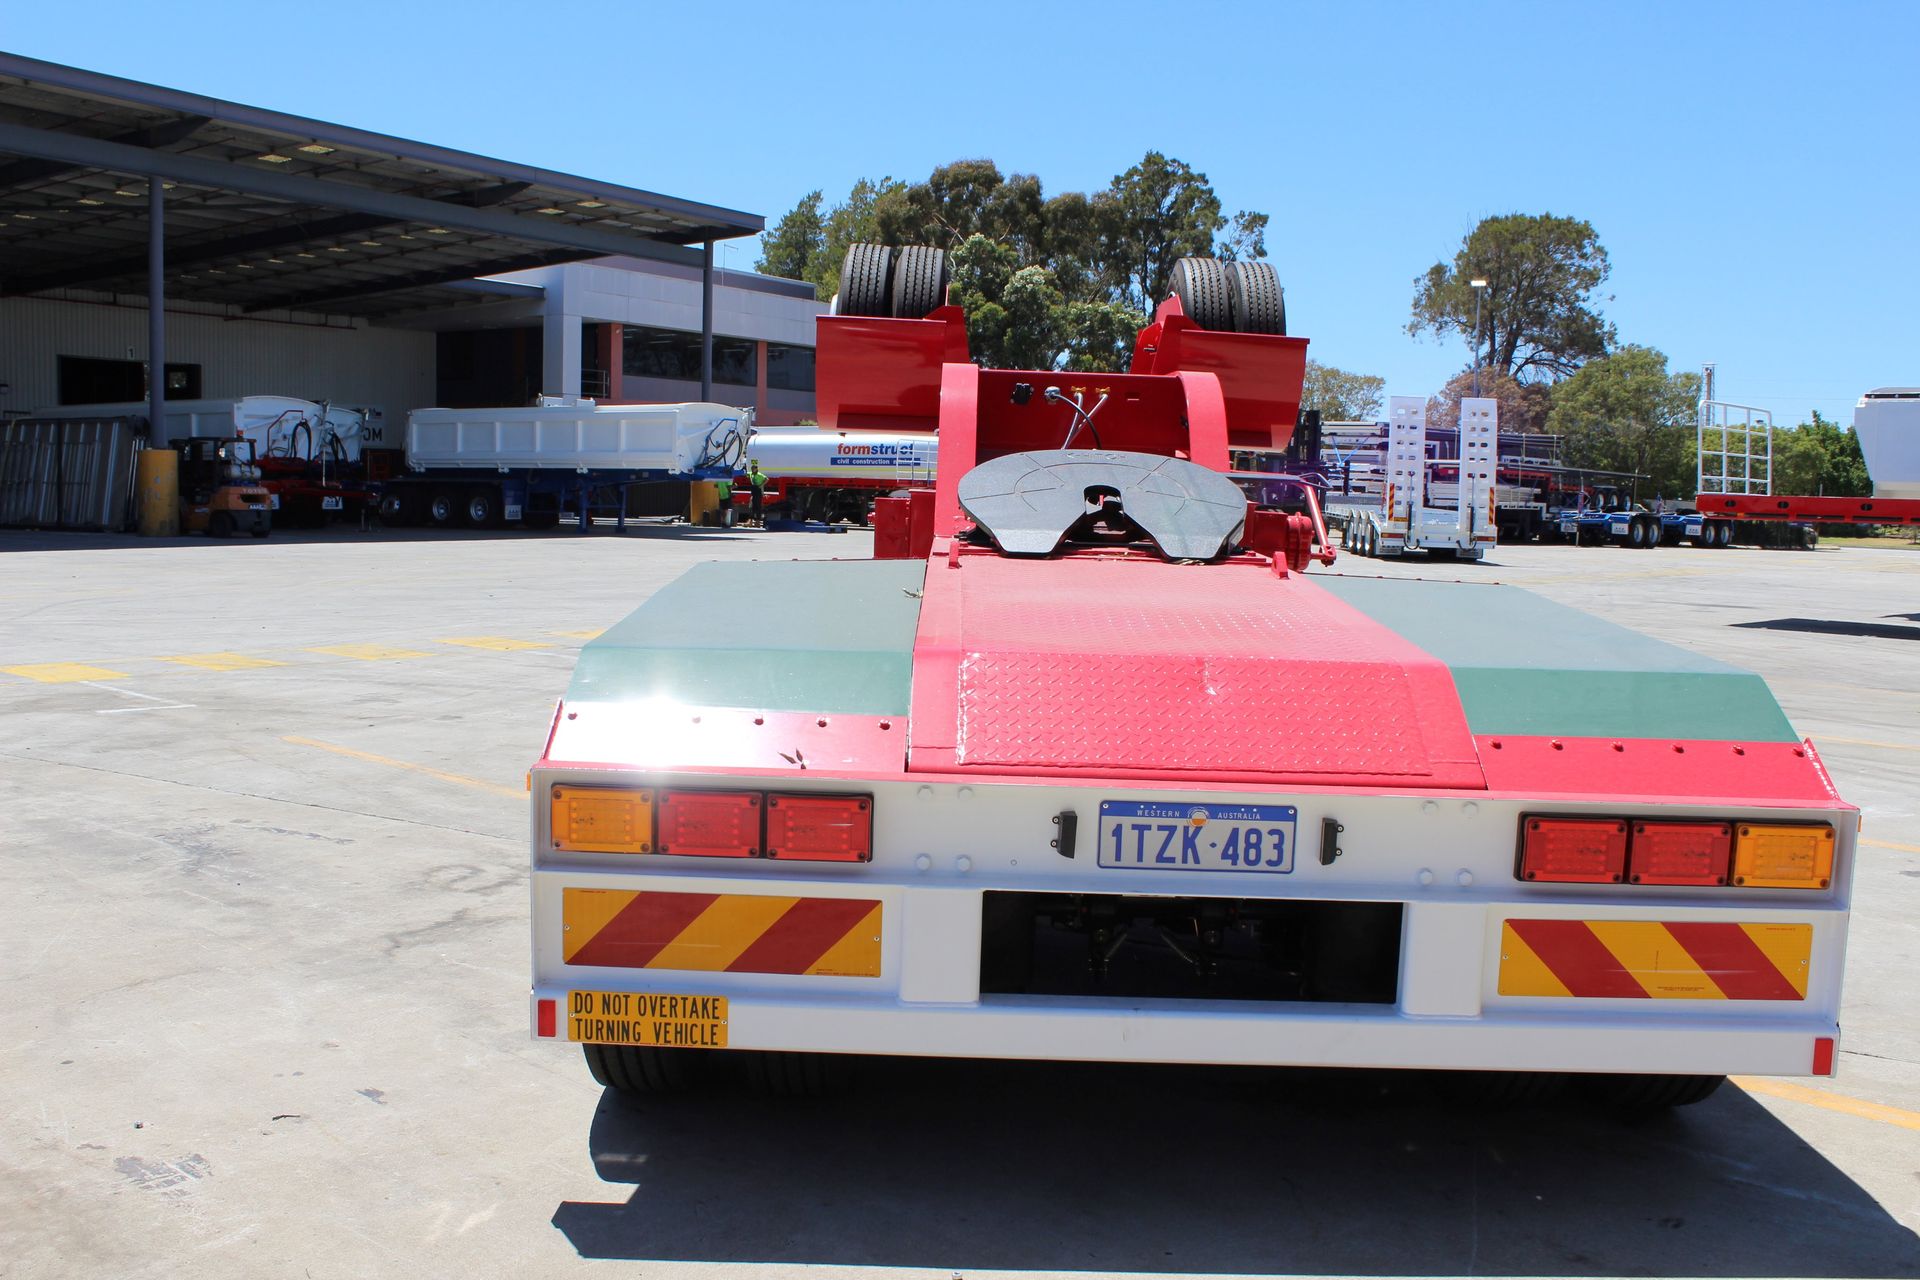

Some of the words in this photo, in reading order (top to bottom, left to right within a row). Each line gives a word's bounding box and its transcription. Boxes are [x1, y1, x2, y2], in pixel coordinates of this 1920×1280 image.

[837, 443, 913, 455] formstruct
[1217, 812, 1261, 820] AUSTRALIA
[574, 992, 593, 1014] DO
[602, 993, 631, 1016] NOT
[637, 995, 720, 1020] OVERTAKE
[576, 1018, 641, 1042] TURNING
[653, 1021, 719, 1046] VEHICLE
